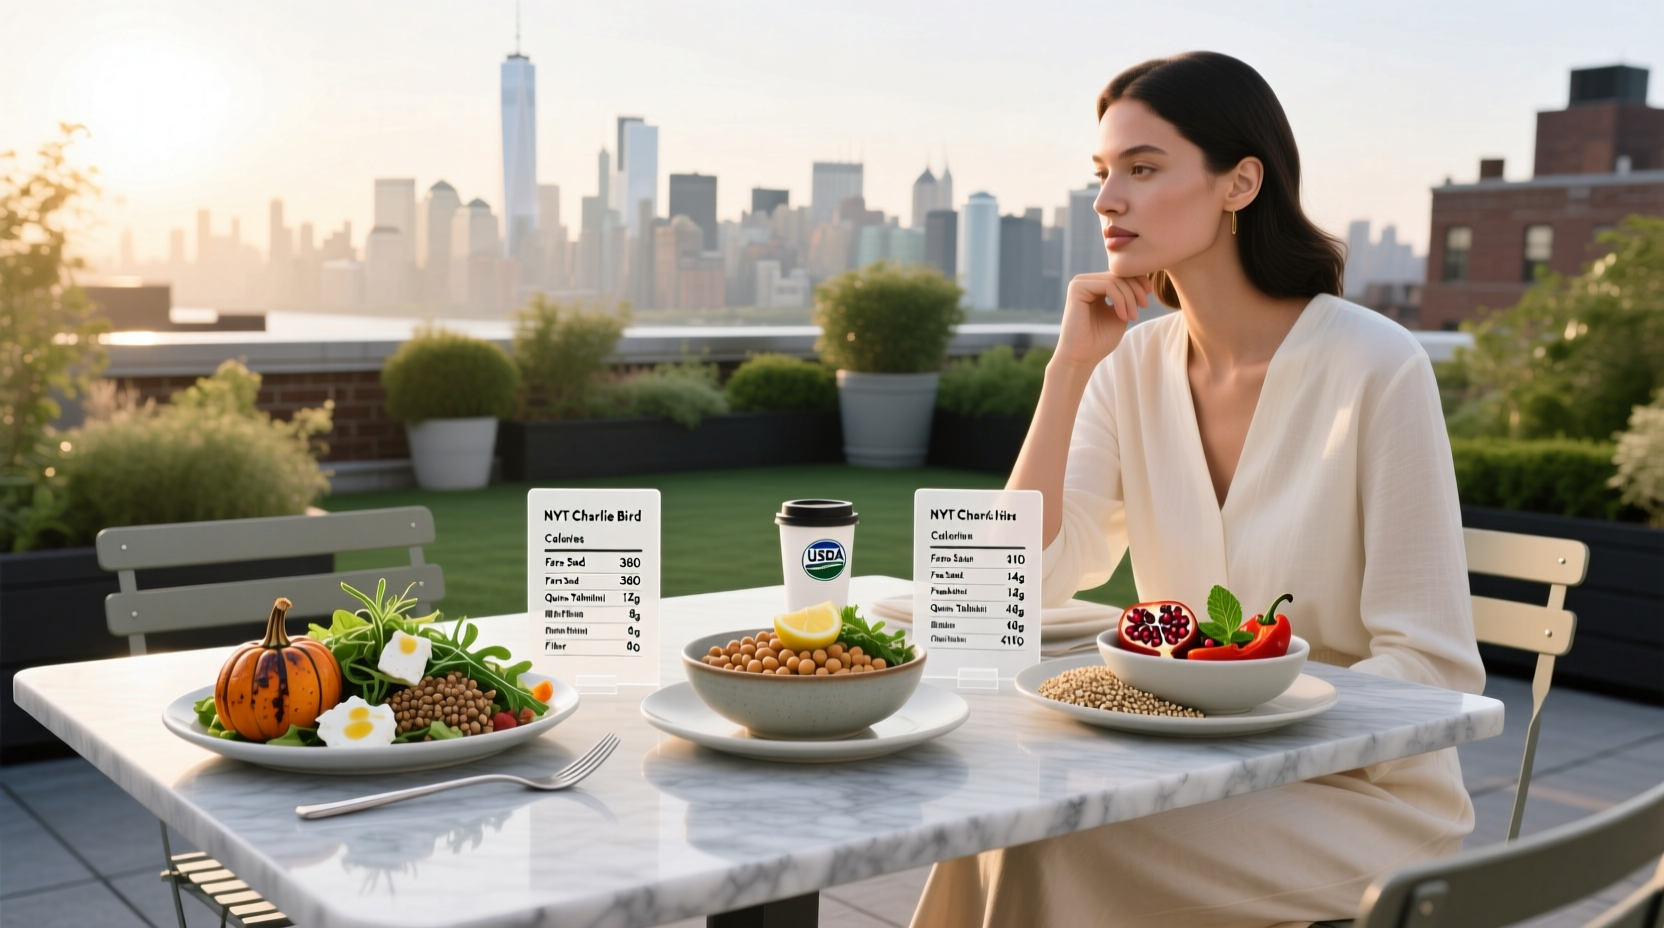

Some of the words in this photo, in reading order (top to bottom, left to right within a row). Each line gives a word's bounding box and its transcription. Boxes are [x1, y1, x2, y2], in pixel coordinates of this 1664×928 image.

[544, 509, 570, 522] NYT
[572, 509, 615, 522] Charlie
[617, 509, 642, 522] Bird
[930, 508, 956, 521] NYT
[808, 547, 844, 562] USDA
